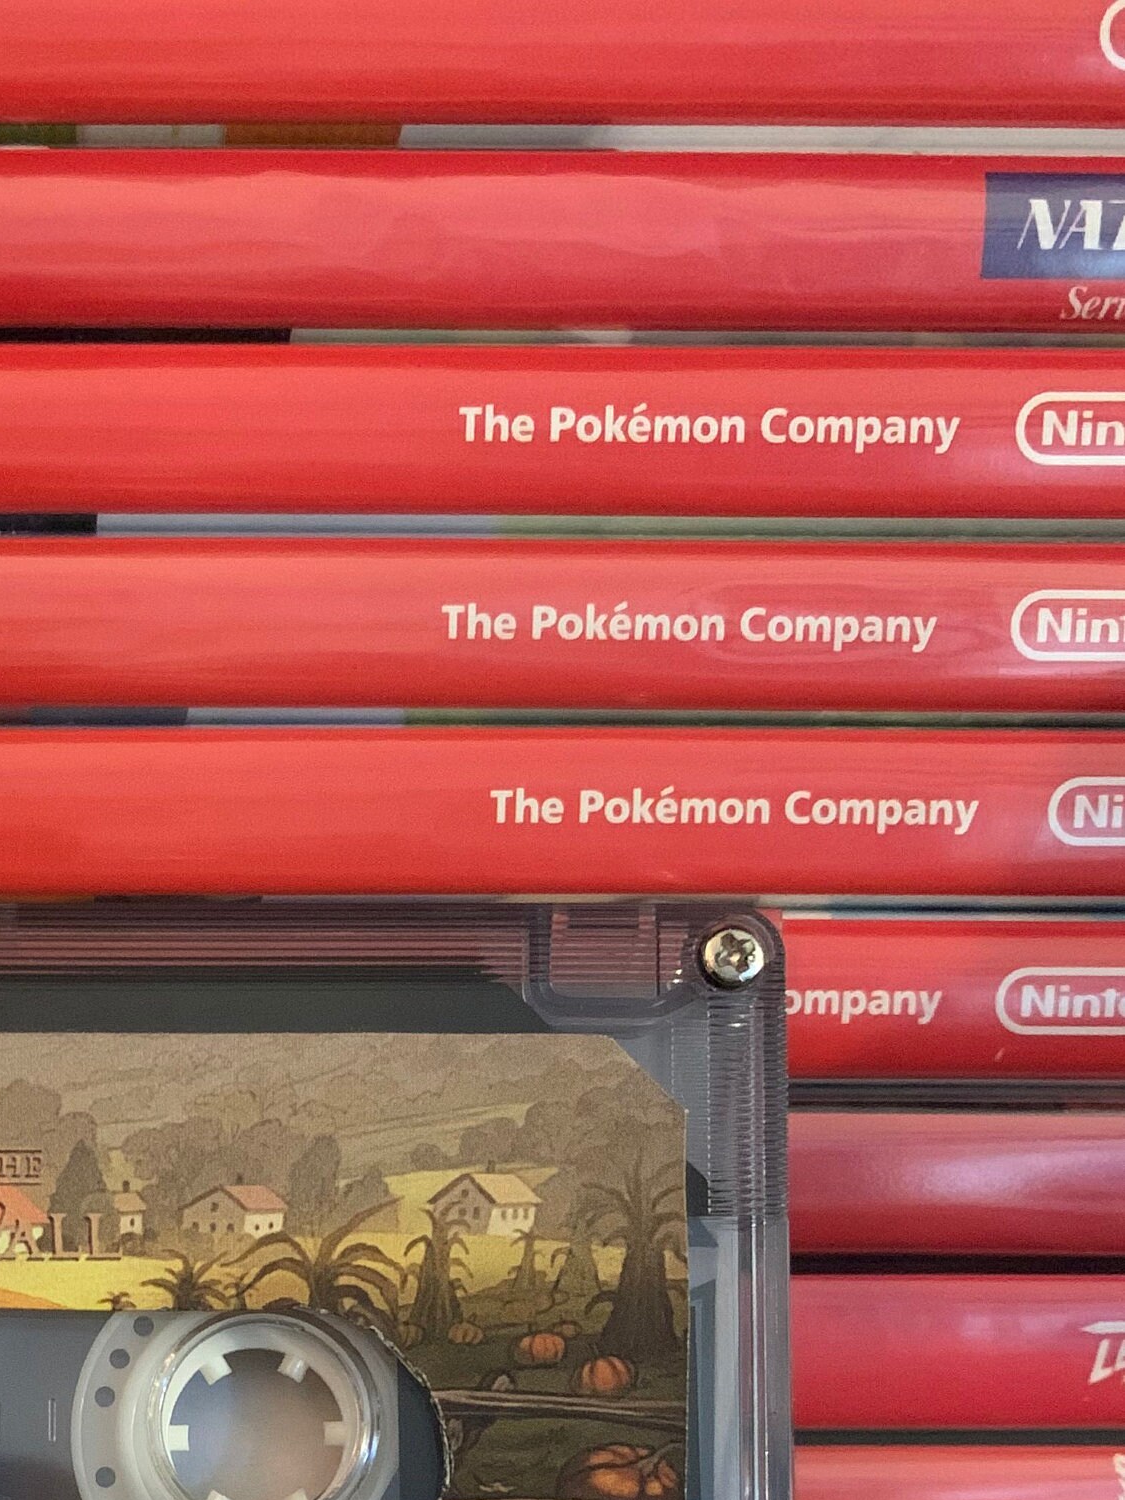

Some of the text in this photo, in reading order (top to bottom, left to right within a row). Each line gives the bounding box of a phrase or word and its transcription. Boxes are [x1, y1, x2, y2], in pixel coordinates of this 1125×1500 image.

[459, 402, 961, 454] The Pokémon Company
[1040, 409, 1125, 446] Nin
[441, 601, 937, 652] The Pokémon Company
[1036, 607, 1125, 643] Nin
[490, 785, 979, 835] The Pokémon Company
[1073, 794, 1124, 828] Ni
